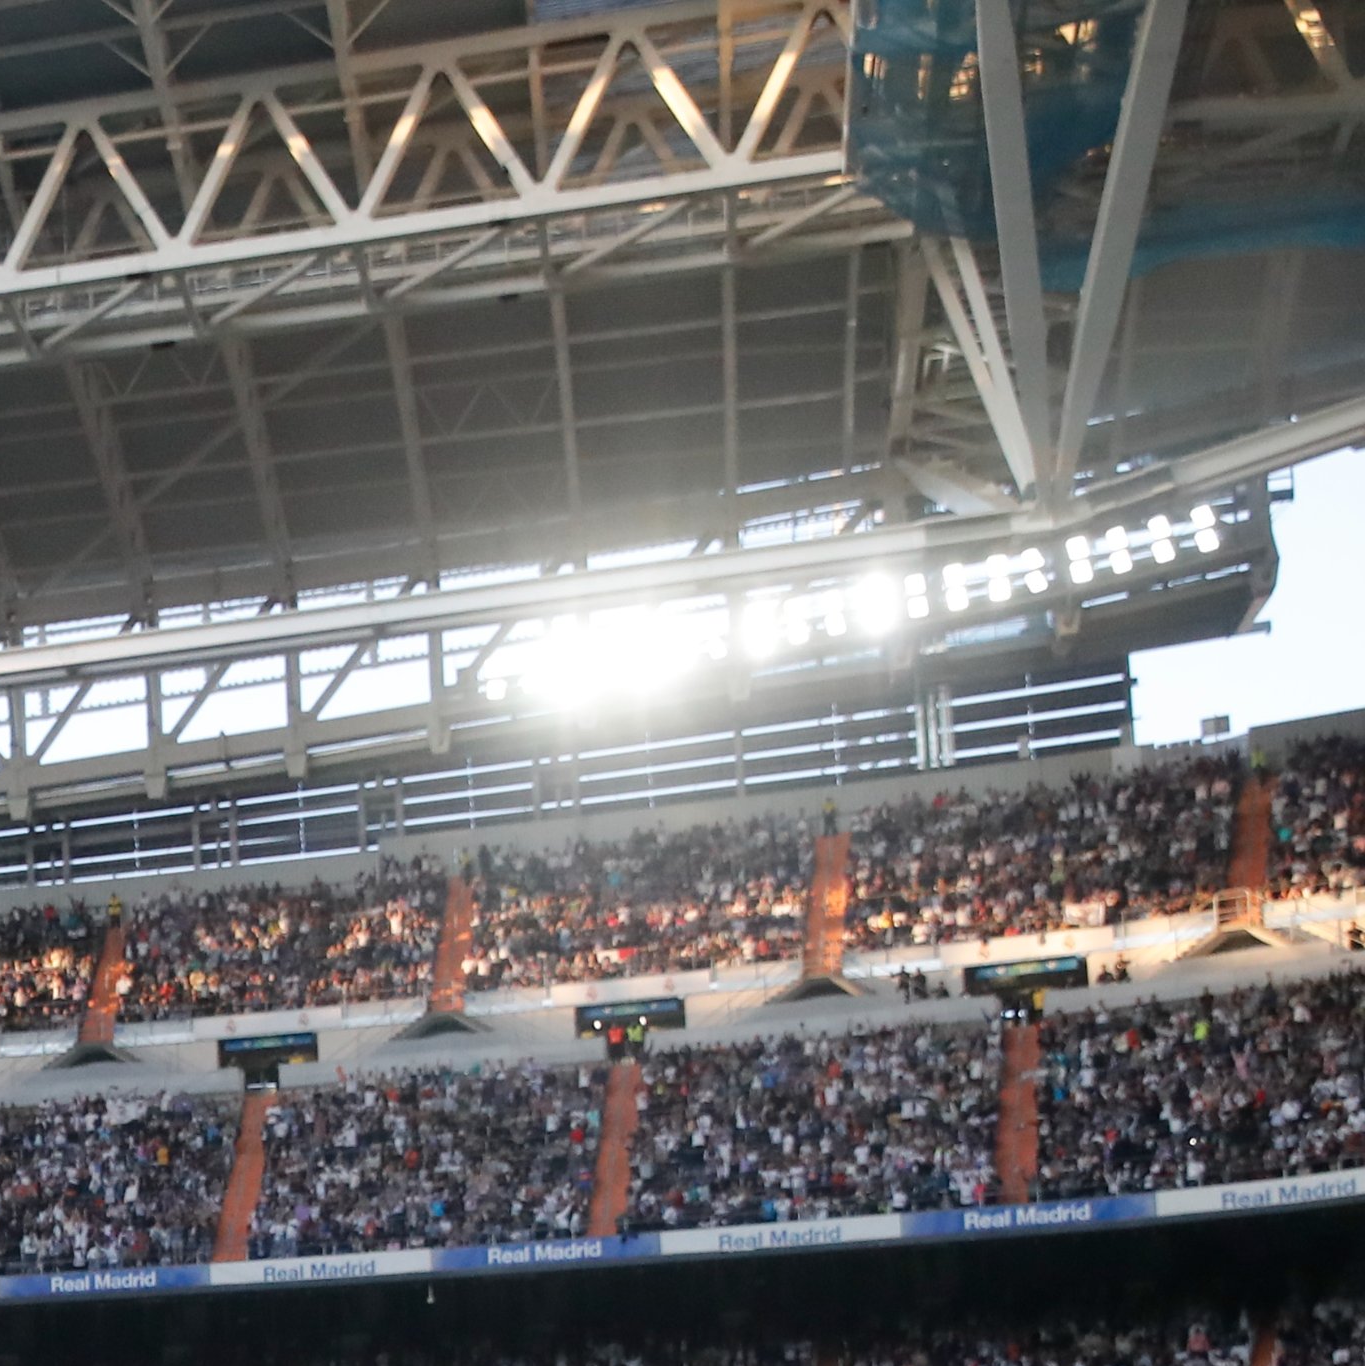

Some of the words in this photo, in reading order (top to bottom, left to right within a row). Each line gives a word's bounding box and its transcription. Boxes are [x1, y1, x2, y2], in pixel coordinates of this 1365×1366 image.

[1220, 1190, 1270, 1210] Real
[1277, 1178, 1357, 1206] Madrid
[963, 1210, 1010, 1230] Real
[1015, 1203, 1092, 1226] Madrid
[719, 1232, 763, 1251] Real
[769, 1225, 842, 1247] Madrid
[487, 1247, 530, 1265] Real
[534, 1241, 603, 1262] Madrid
[50, 1275, 90, 1293] Real
[94, 1271, 157, 1290] Madrid
[262, 1264, 304, 1283] Real
[309, 1260, 377, 1280] Madrid
